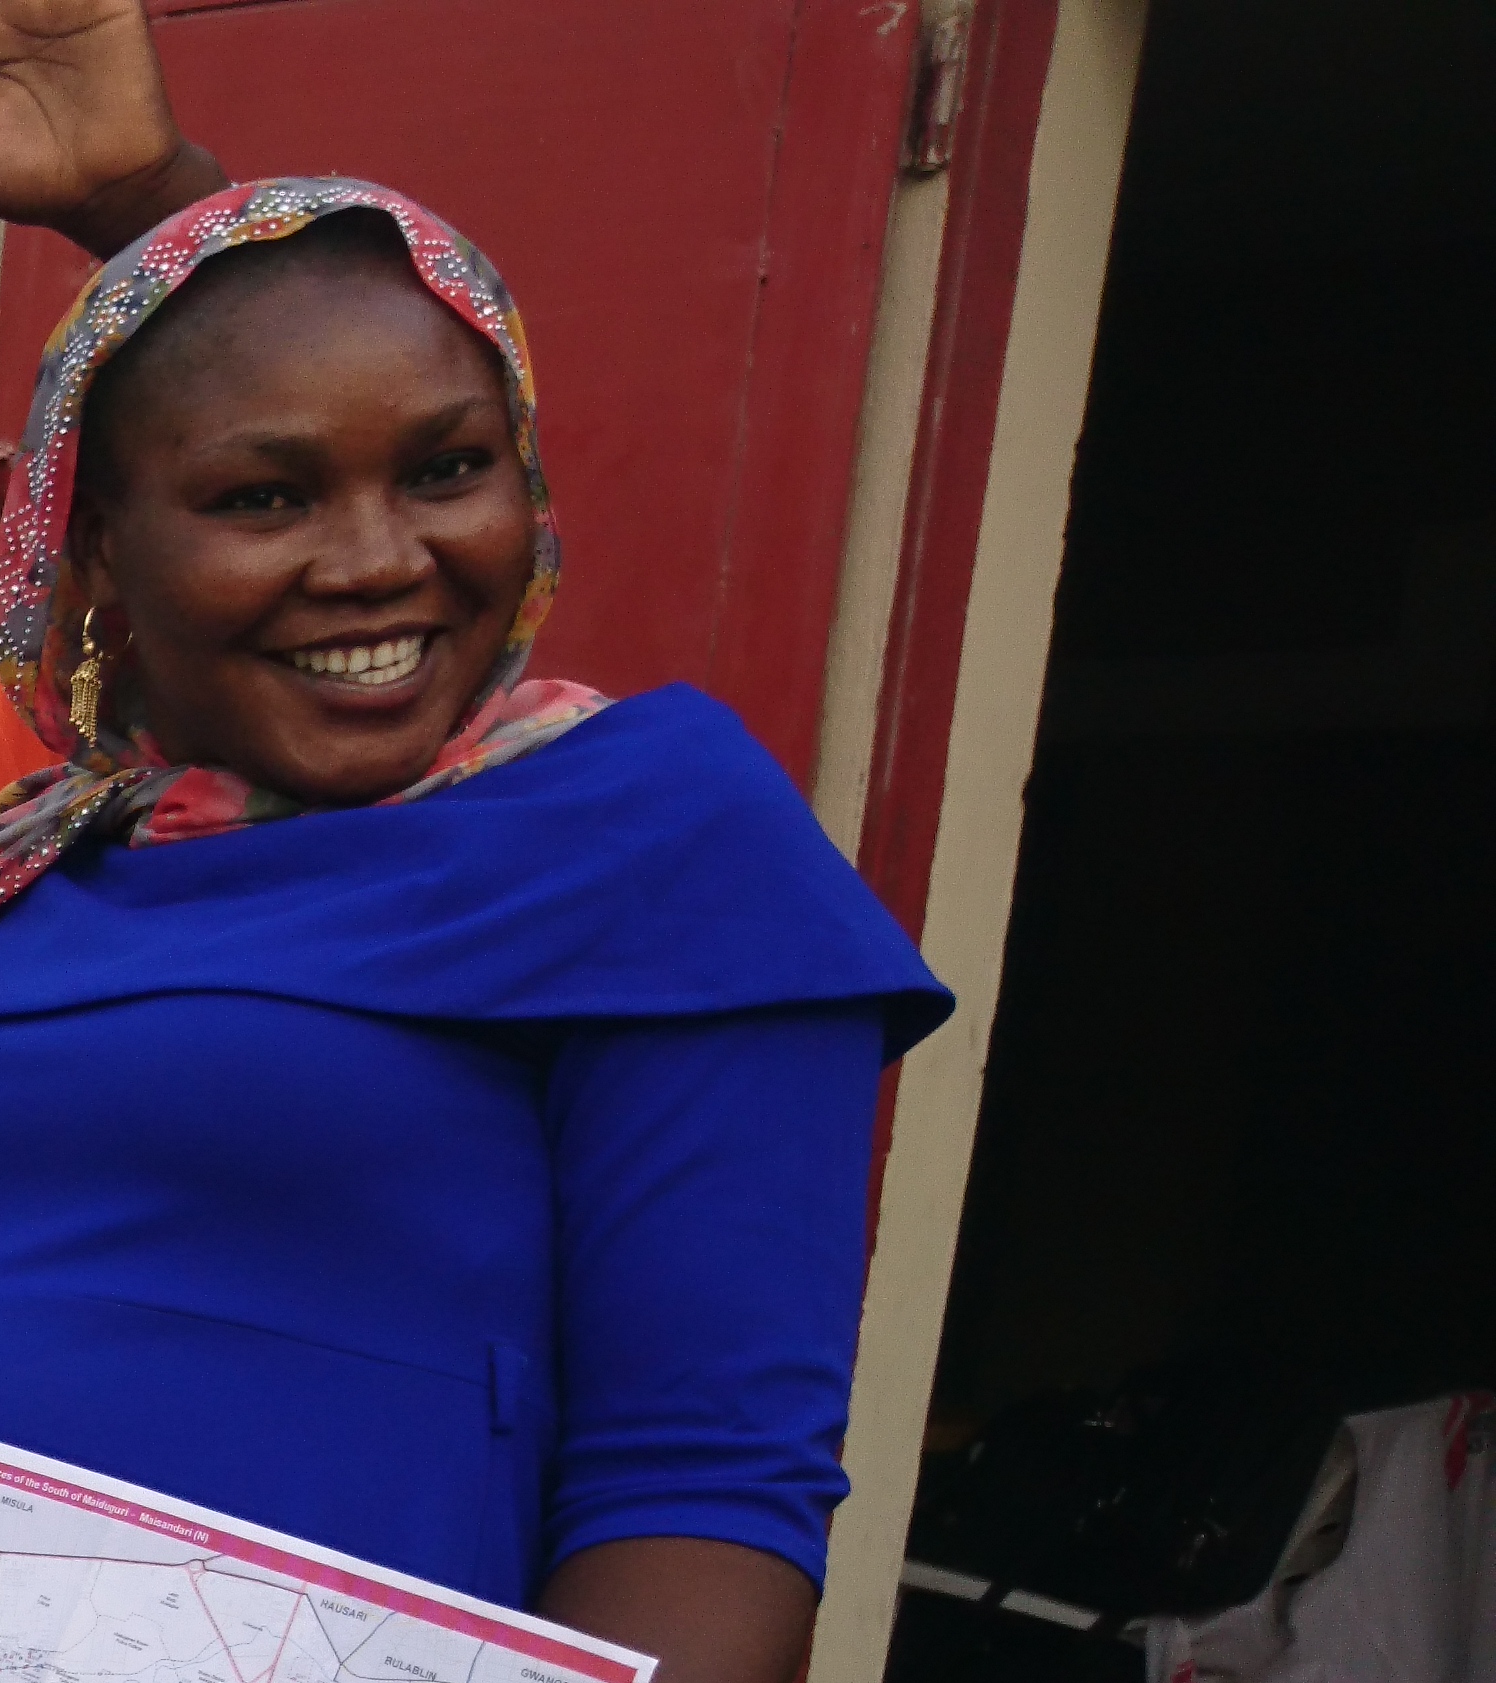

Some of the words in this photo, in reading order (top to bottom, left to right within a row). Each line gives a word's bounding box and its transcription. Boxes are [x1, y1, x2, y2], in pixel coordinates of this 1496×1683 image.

[12, 1472, 25, 1486] of
[23, 1476, 41, 1490] the
[40, 1481, 71, 1500] South
[69, 1490, 84, 1504] of
[81, 1494, 129, 1518] Maiduguri
[137, 1511, 193, 1537] Maisandari
[192, 1528, 210, 1543] (N)
[320, 1598, 367, 1622] HAUSARI
[384, 1655, 437, 1682] BULABLIN
